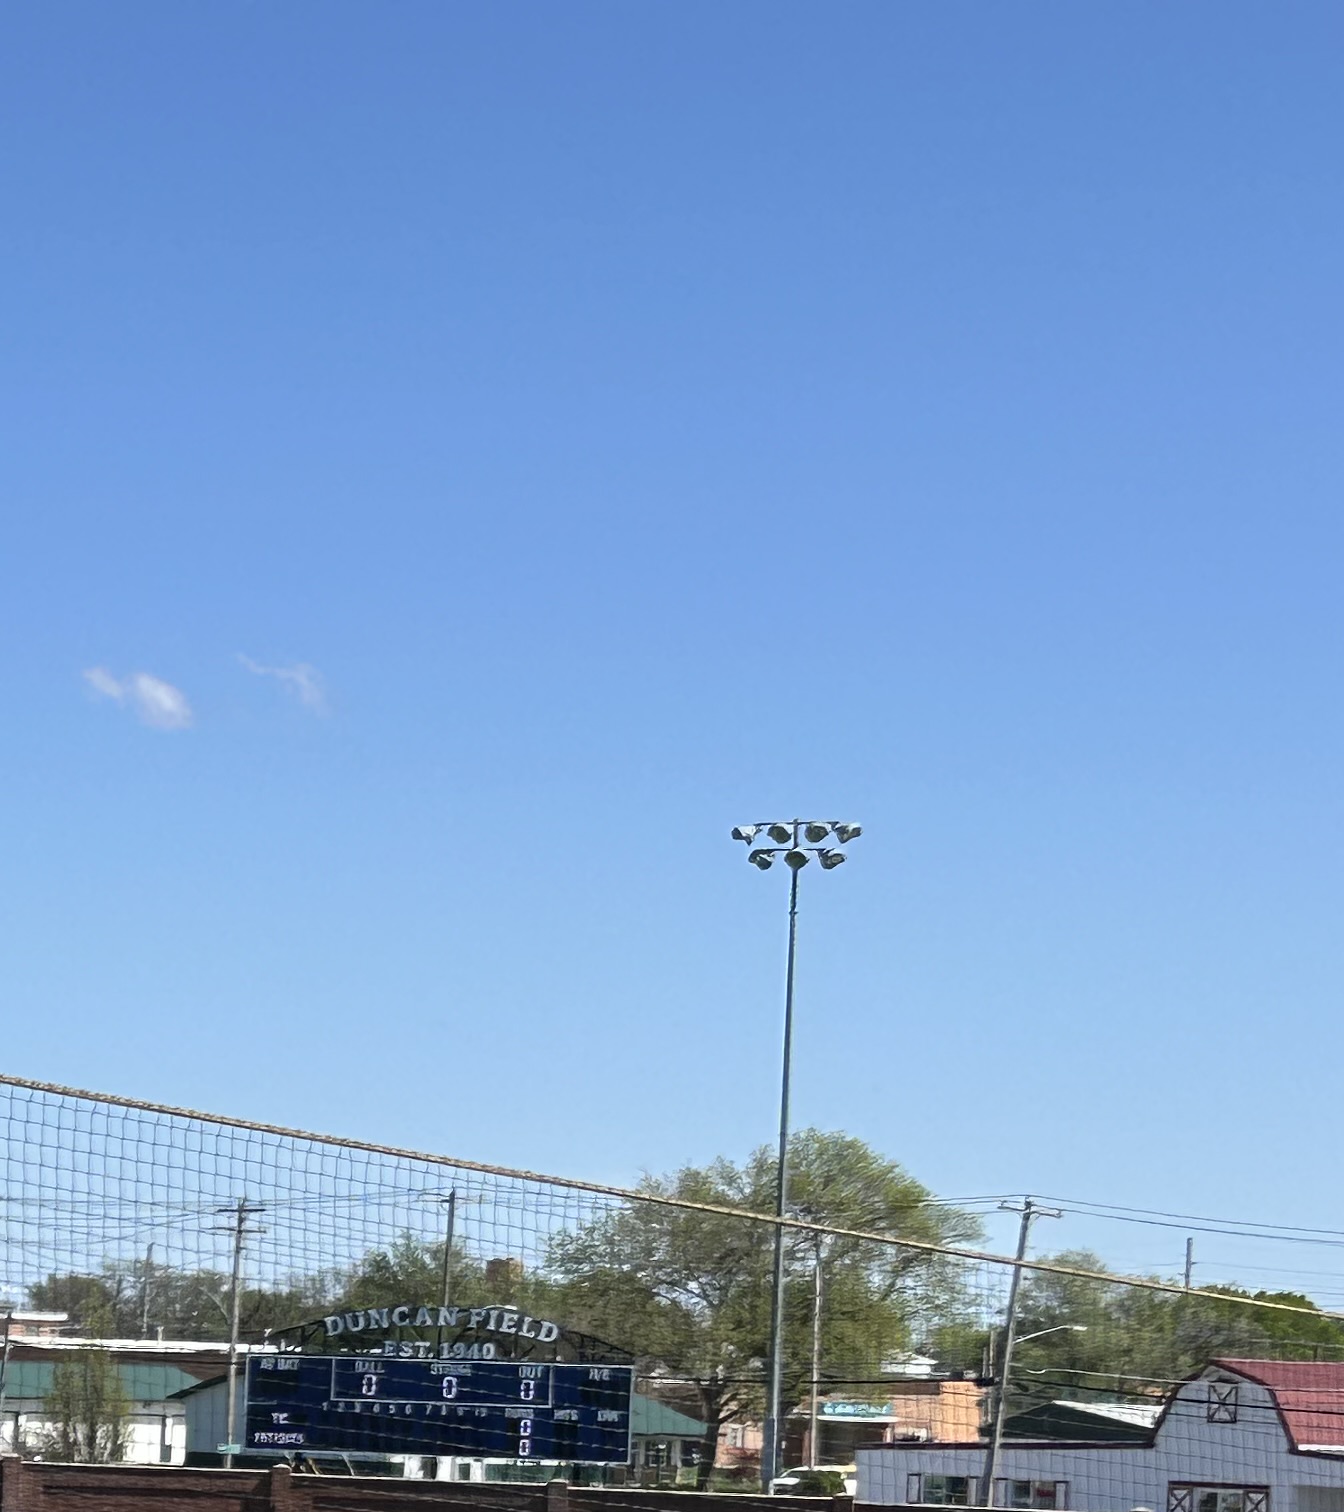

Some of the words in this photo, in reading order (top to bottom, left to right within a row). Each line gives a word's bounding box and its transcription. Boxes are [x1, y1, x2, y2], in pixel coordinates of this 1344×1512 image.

[324, 1306, 459, 1336] DUNCAN
[467, 1308, 559, 1342] FIELD
[383, 1341, 434, 1359] EST.
[439, 1342, 496, 1359] 1940
[518, 1366, 543, 1379] OUT
[442, 1376, 458, 1399] 0
[520, 1380, 534, 1401] 0
[519, 1420, 531, 1437] 0
[518, 1439, 531, 1456] 0
